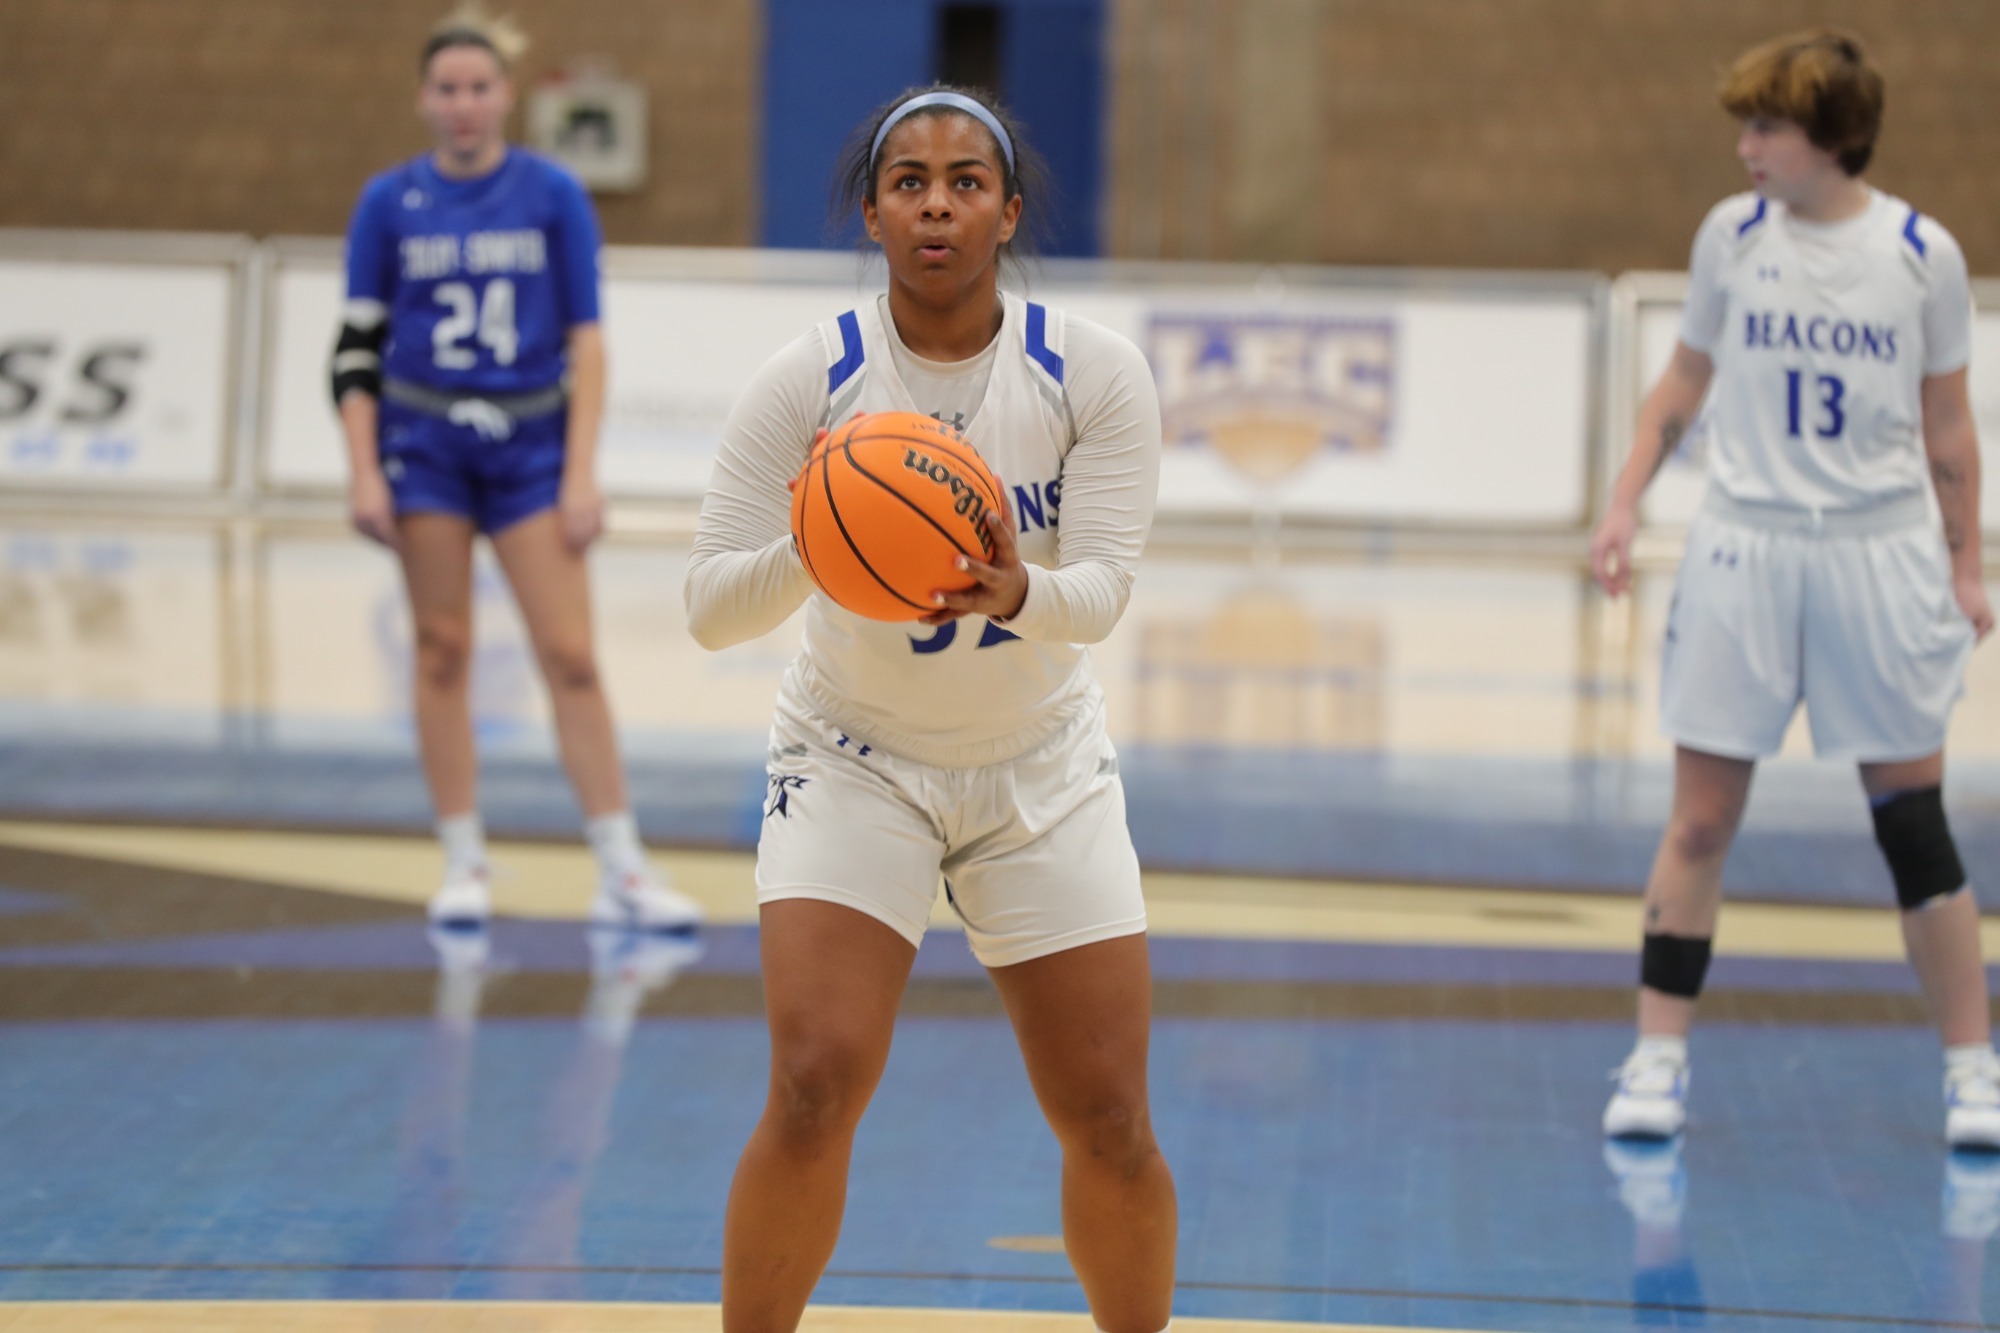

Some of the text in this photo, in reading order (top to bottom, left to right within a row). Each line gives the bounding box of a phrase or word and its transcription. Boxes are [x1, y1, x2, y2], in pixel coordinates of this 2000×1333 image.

[431, 278, 519, 370] 24
[1744, 310, 1898, 363] BEACONS
[1786, 369, 1846, 439] 13
